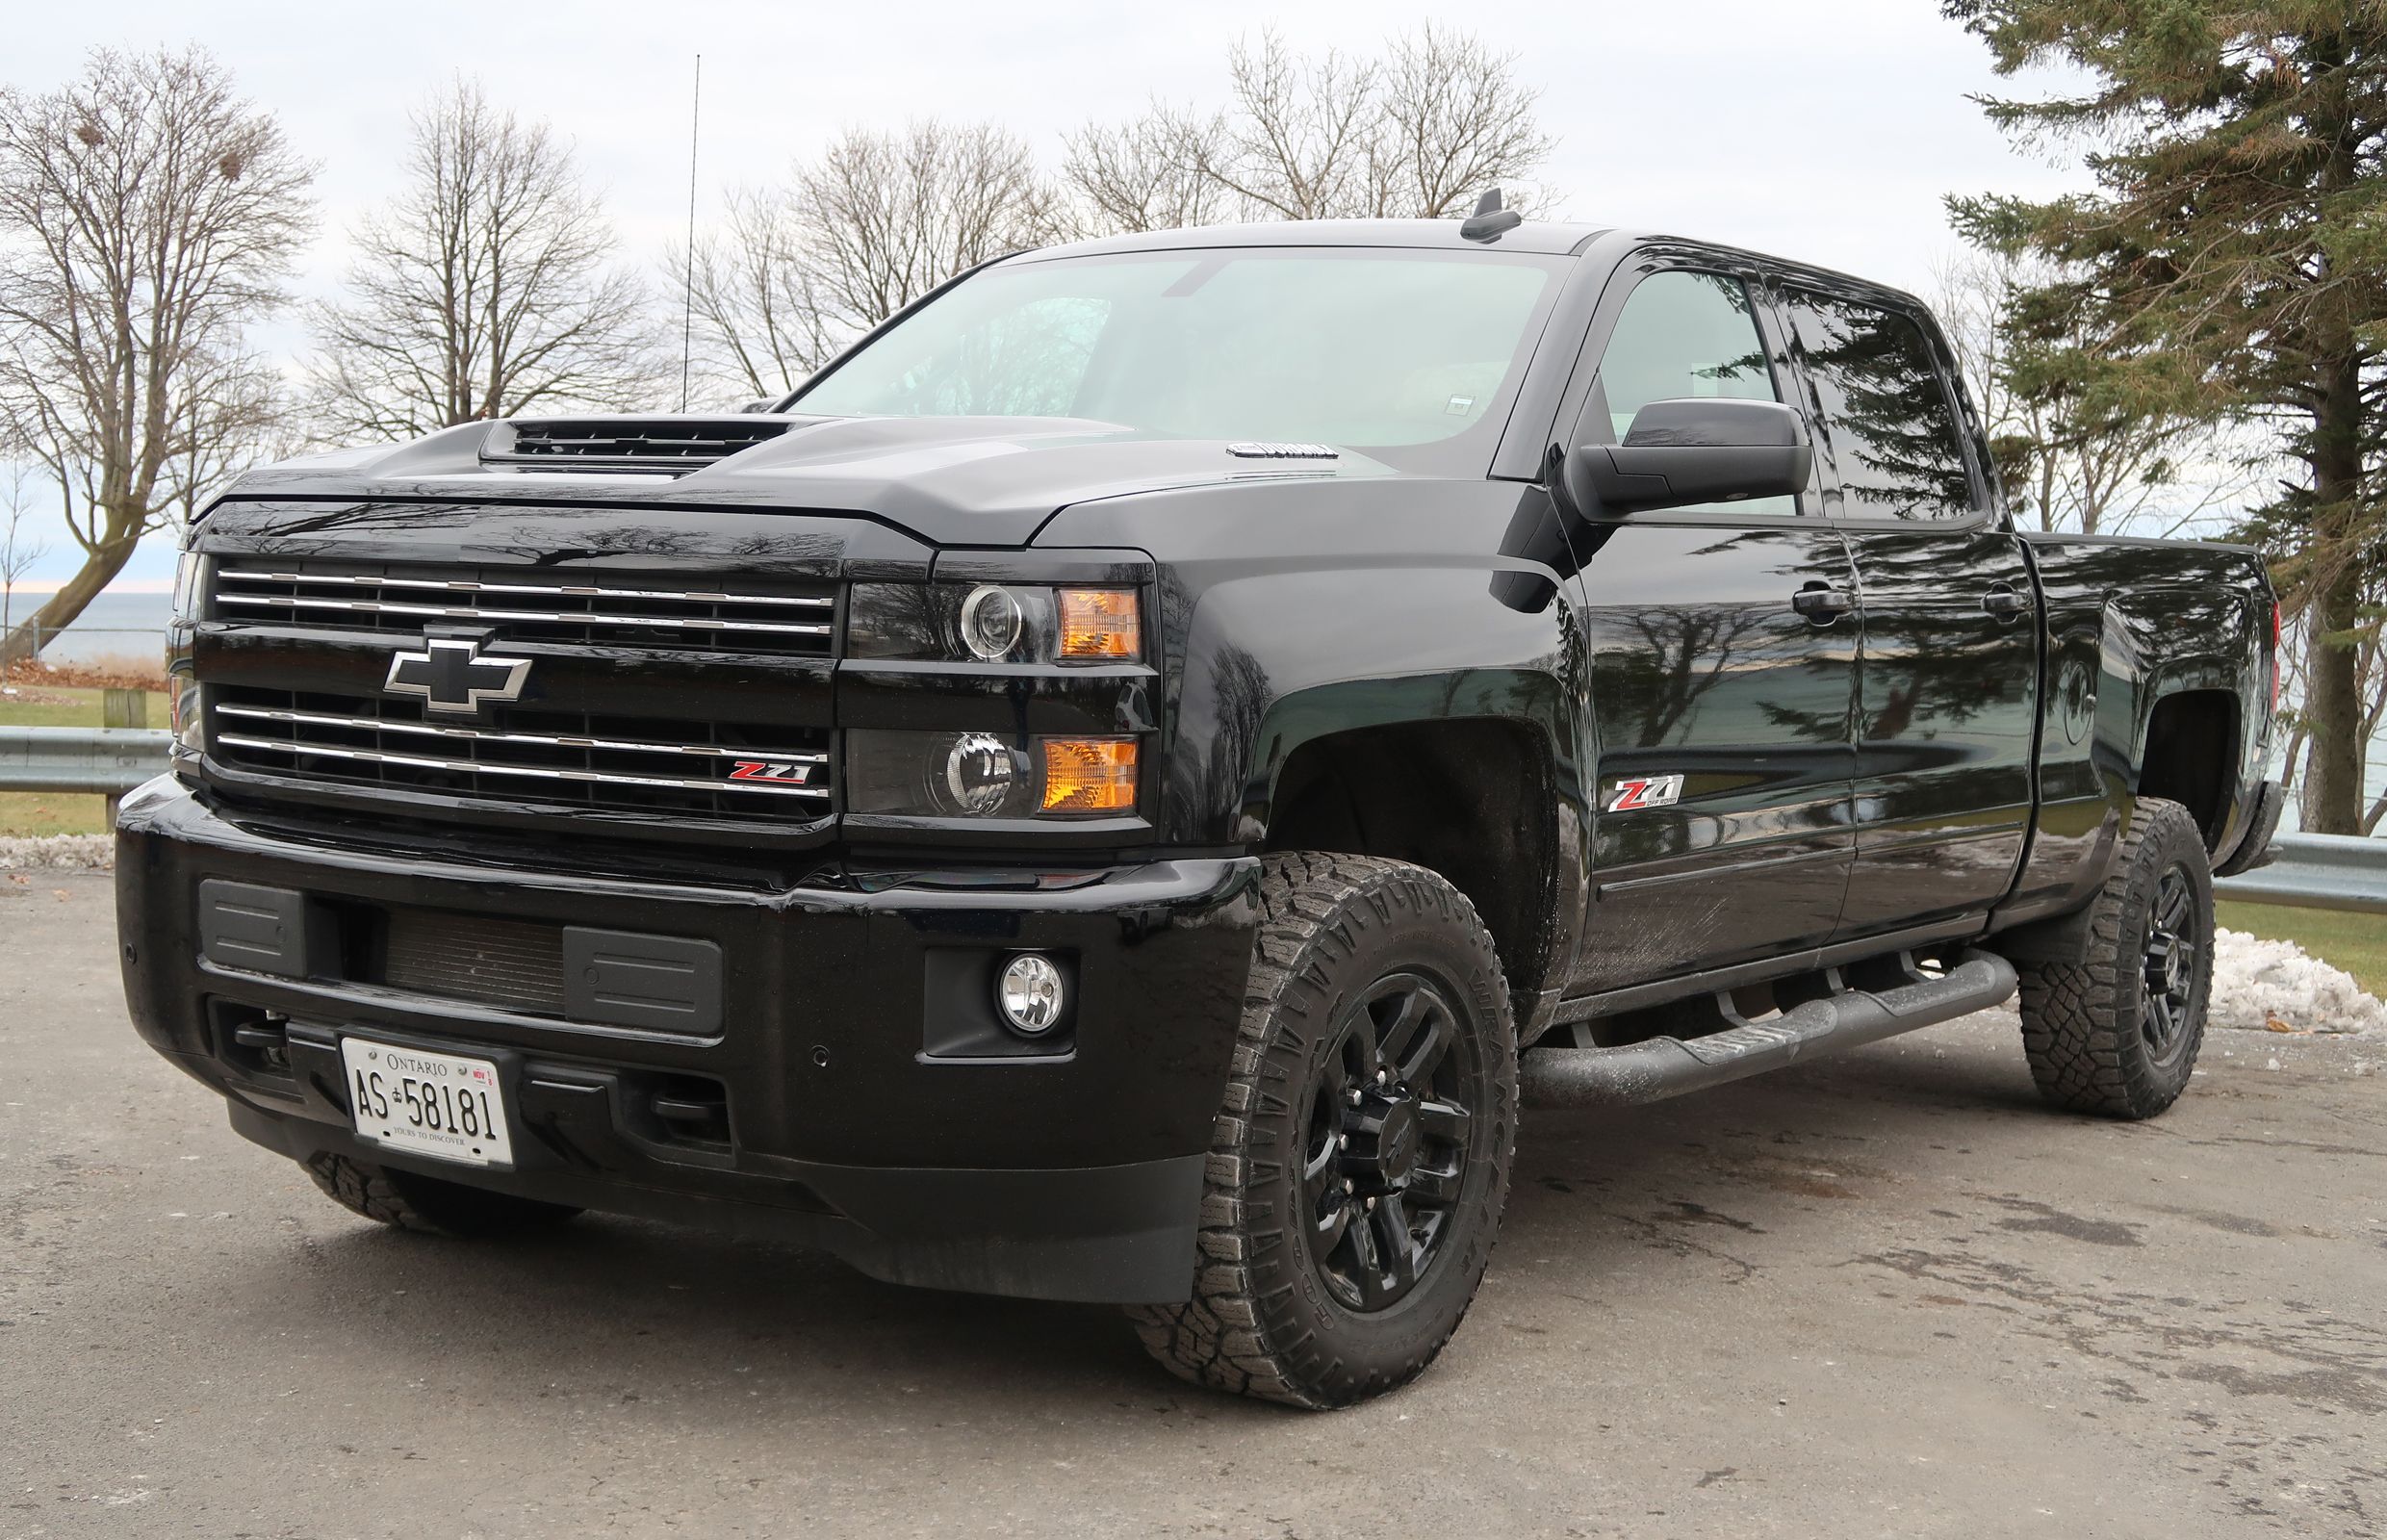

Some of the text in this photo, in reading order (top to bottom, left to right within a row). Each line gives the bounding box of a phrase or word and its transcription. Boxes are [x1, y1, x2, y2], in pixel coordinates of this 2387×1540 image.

[728, 761, 811, 783] Z71
[1608, 775, 1684, 812] Z71
[387, 1053, 448, 1077] ONTARIO
[355, 1068, 497, 1141] AS 58181
[393, 1126, 466, 1146] YOURS TO DISCOVER
